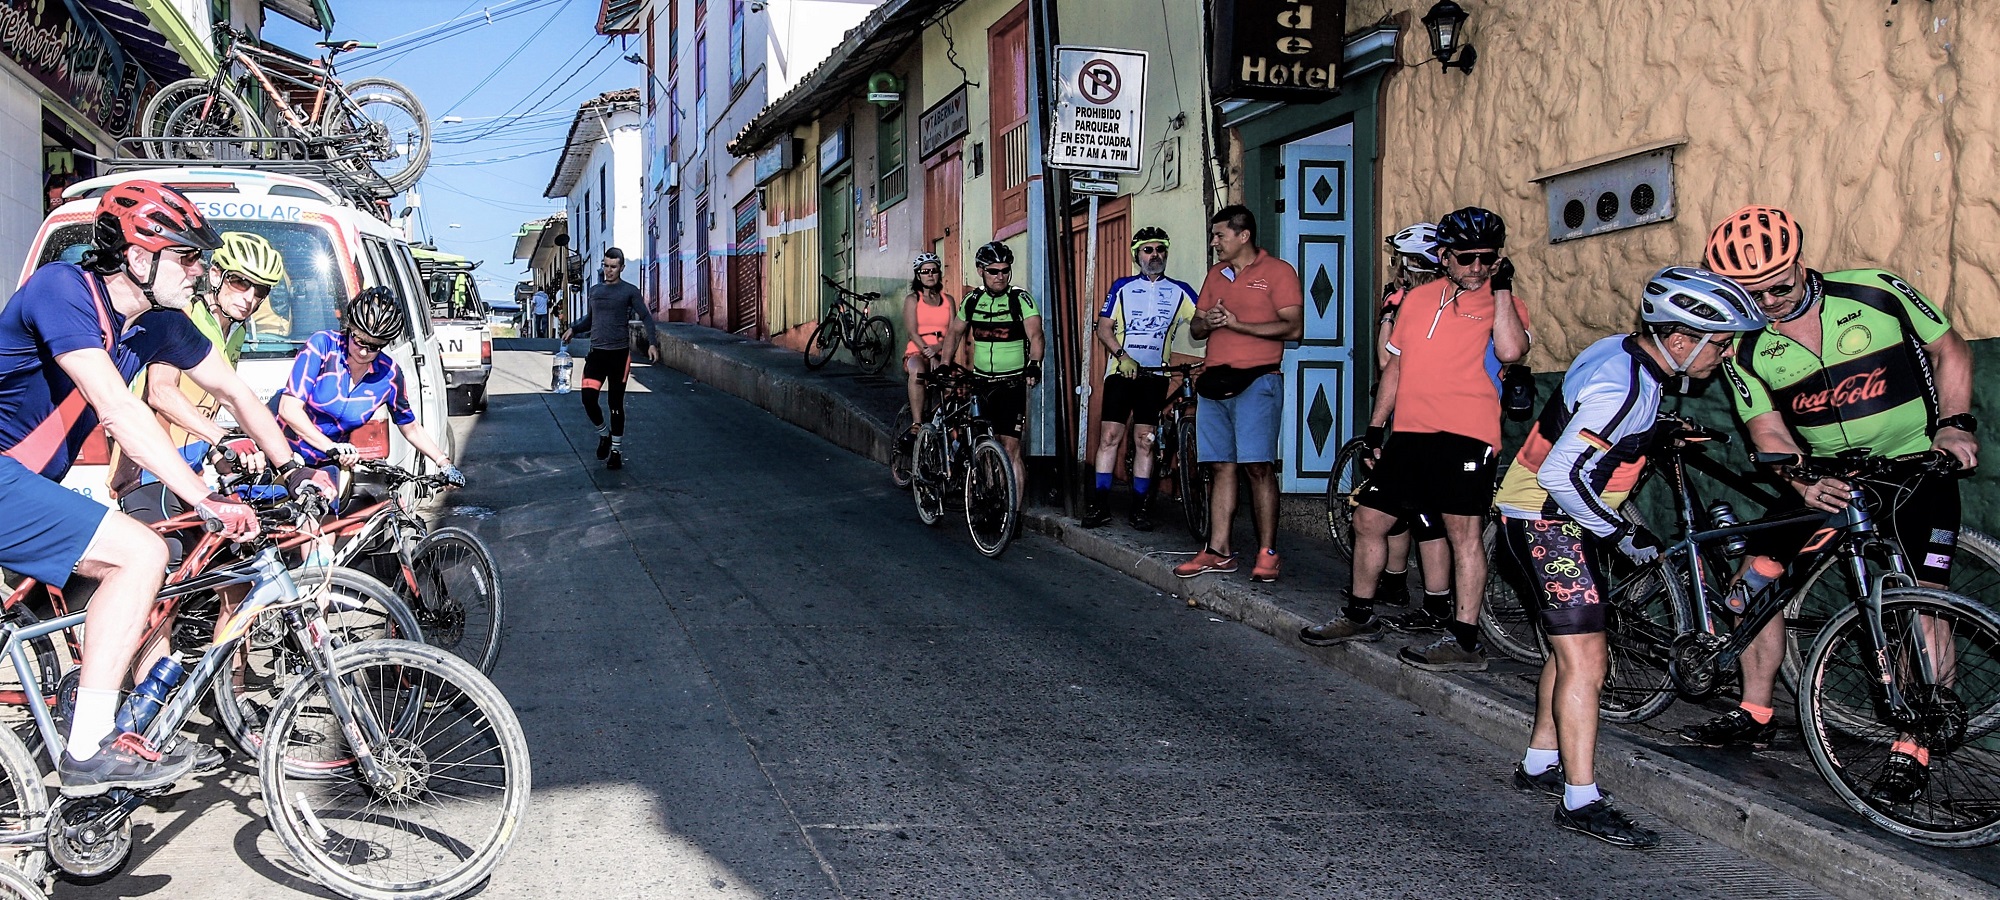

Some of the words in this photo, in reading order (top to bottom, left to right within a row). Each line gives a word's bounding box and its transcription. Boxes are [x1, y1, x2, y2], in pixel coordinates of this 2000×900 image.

[0, 4, 63, 68] remoto
[1276, 0, 1313, 54] de
[1091, 69, 1113, 95] P
[1242, 56, 1336, 88] Hotel
[930, 101, 955, 128] TABERNA
[1075, 106, 1121, 120] PROHIBIDO
[1075, 120, 1120, 133] PARQUEAR
[1060, 132, 1073, 143] EN
[1074, 133, 1096, 145] ESTA
[1097, 135, 1132, 148] CUADRA
[1065, 145, 1077, 156] DE
[1079, 147, 1085, 157] 7
[1086, 147, 1099, 158] AM
[1101, 148, 1107, 159] A
[200, 202, 301, 222] ESCOLAR
[1891, 279, 1935, 319] Condis
[1836, 309, 1862, 326] kalas
[438, 339, 463, 352] AN
